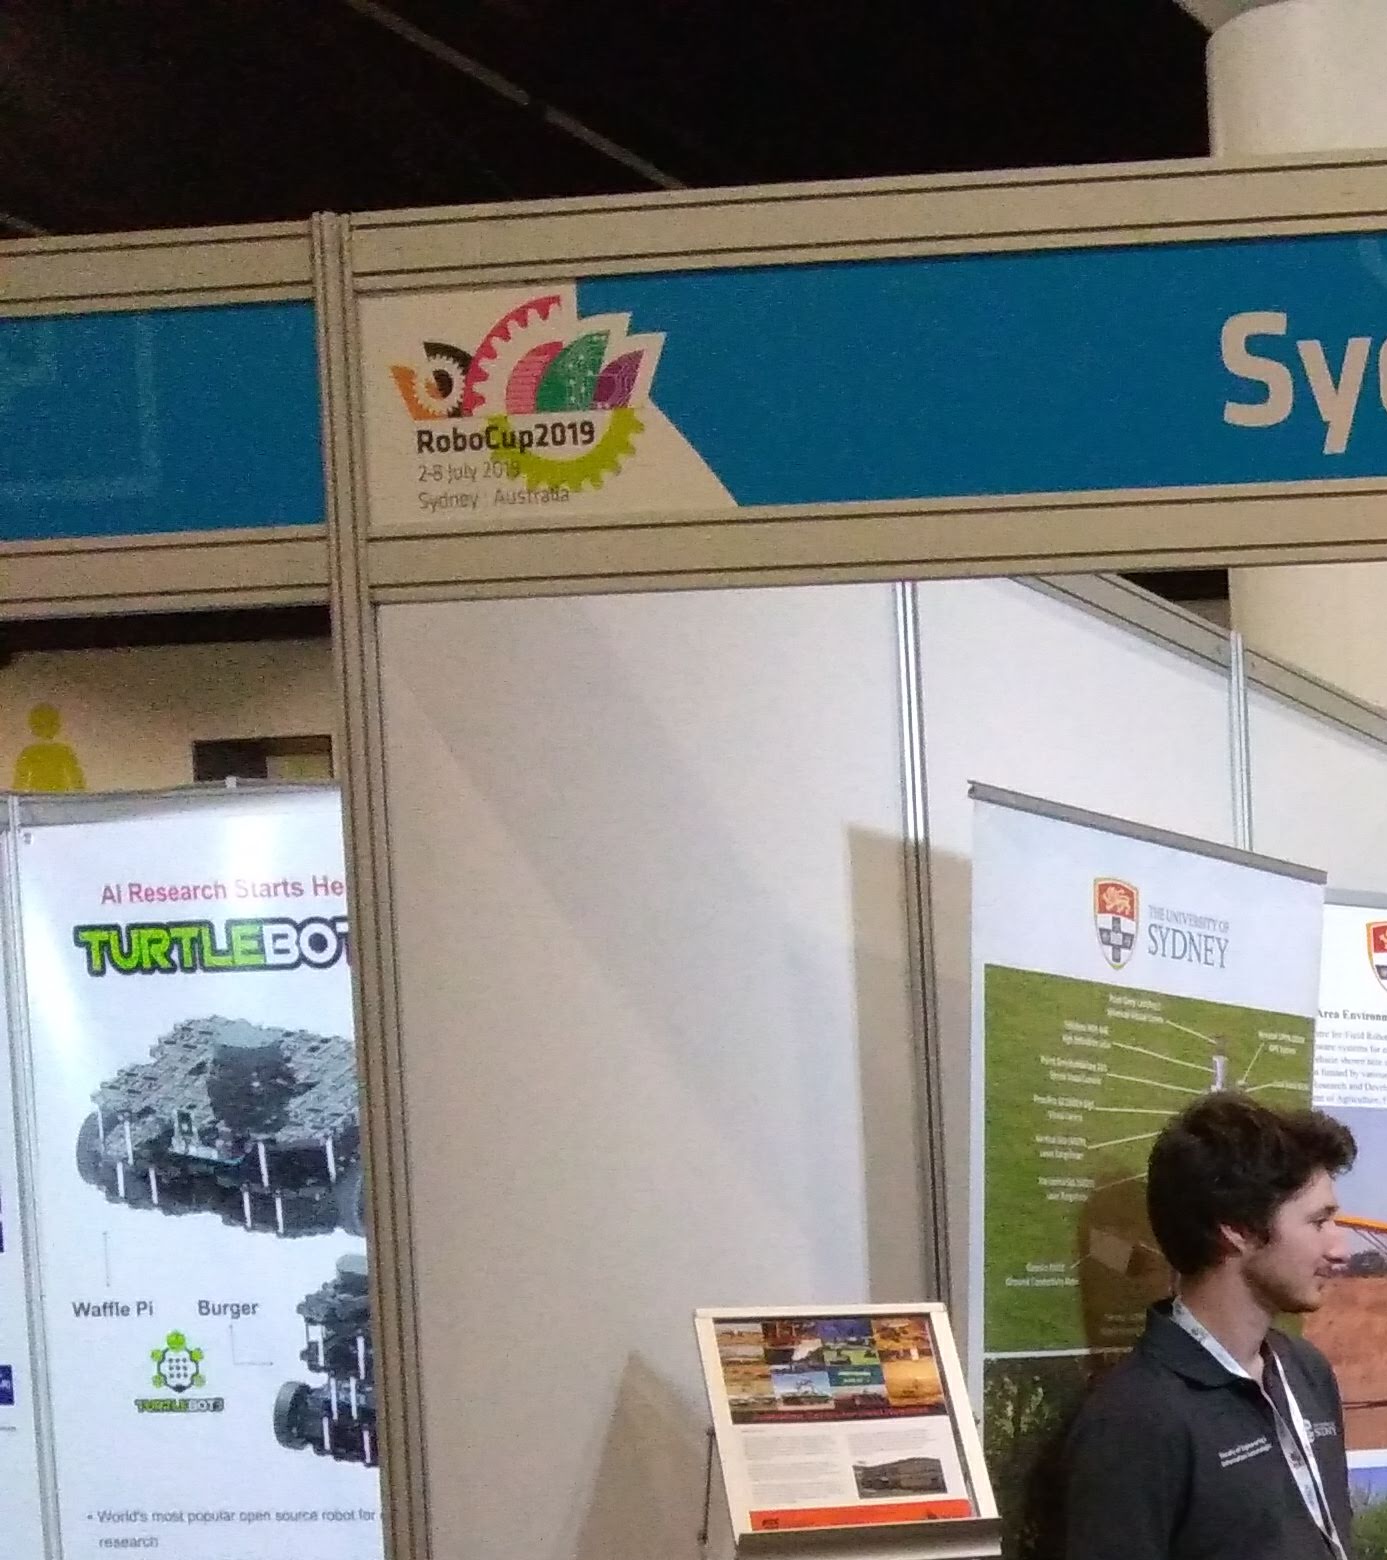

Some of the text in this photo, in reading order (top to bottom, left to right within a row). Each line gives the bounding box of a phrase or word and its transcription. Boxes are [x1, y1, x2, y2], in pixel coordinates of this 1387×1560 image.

[417, 420, 595, 455] RoboCup2019
[418, 491, 479, 512] Sydney
[128, 881, 227, 903] Research
[234, 878, 305, 899] Starts
[1148, 922, 1229, 969] SYDNEY
[72, 1300, 154, 1318] Waffle Pi
[198, 1299, 260, 1319] Burger
